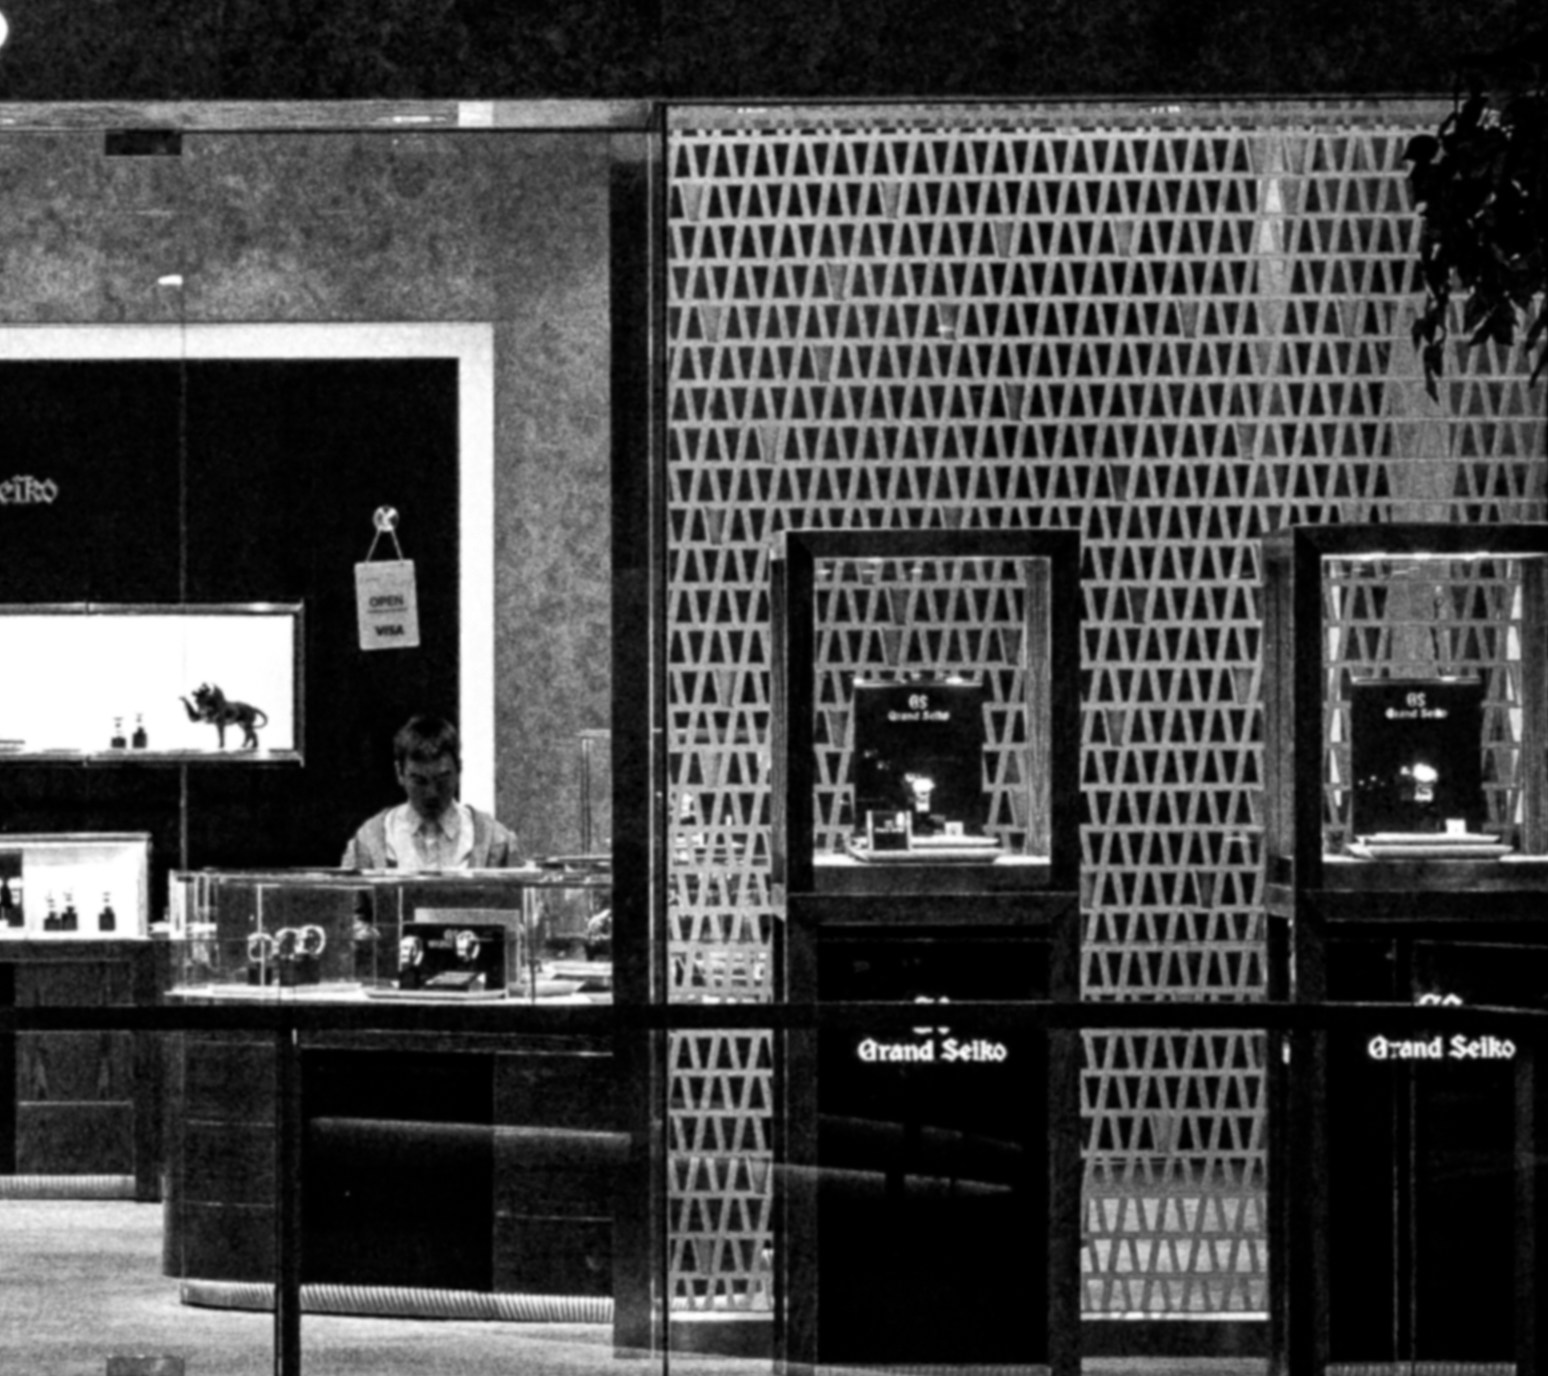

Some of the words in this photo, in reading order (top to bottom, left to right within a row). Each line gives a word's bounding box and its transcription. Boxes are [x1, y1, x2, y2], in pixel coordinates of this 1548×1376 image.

[369, 595, 404, 607] OPEN
[374, 624, 404, 636] VISA
[908, 693, 928, 710] GS
[1406, 691, 1426, 708] GS
[857, 1037, 935, 1062] Grand
[940, 1037, 1008, 1063] Seiko
[1367, 1034, 1444, 1060] Grand
[1449, 1034, 1516, 1060] Seiko
